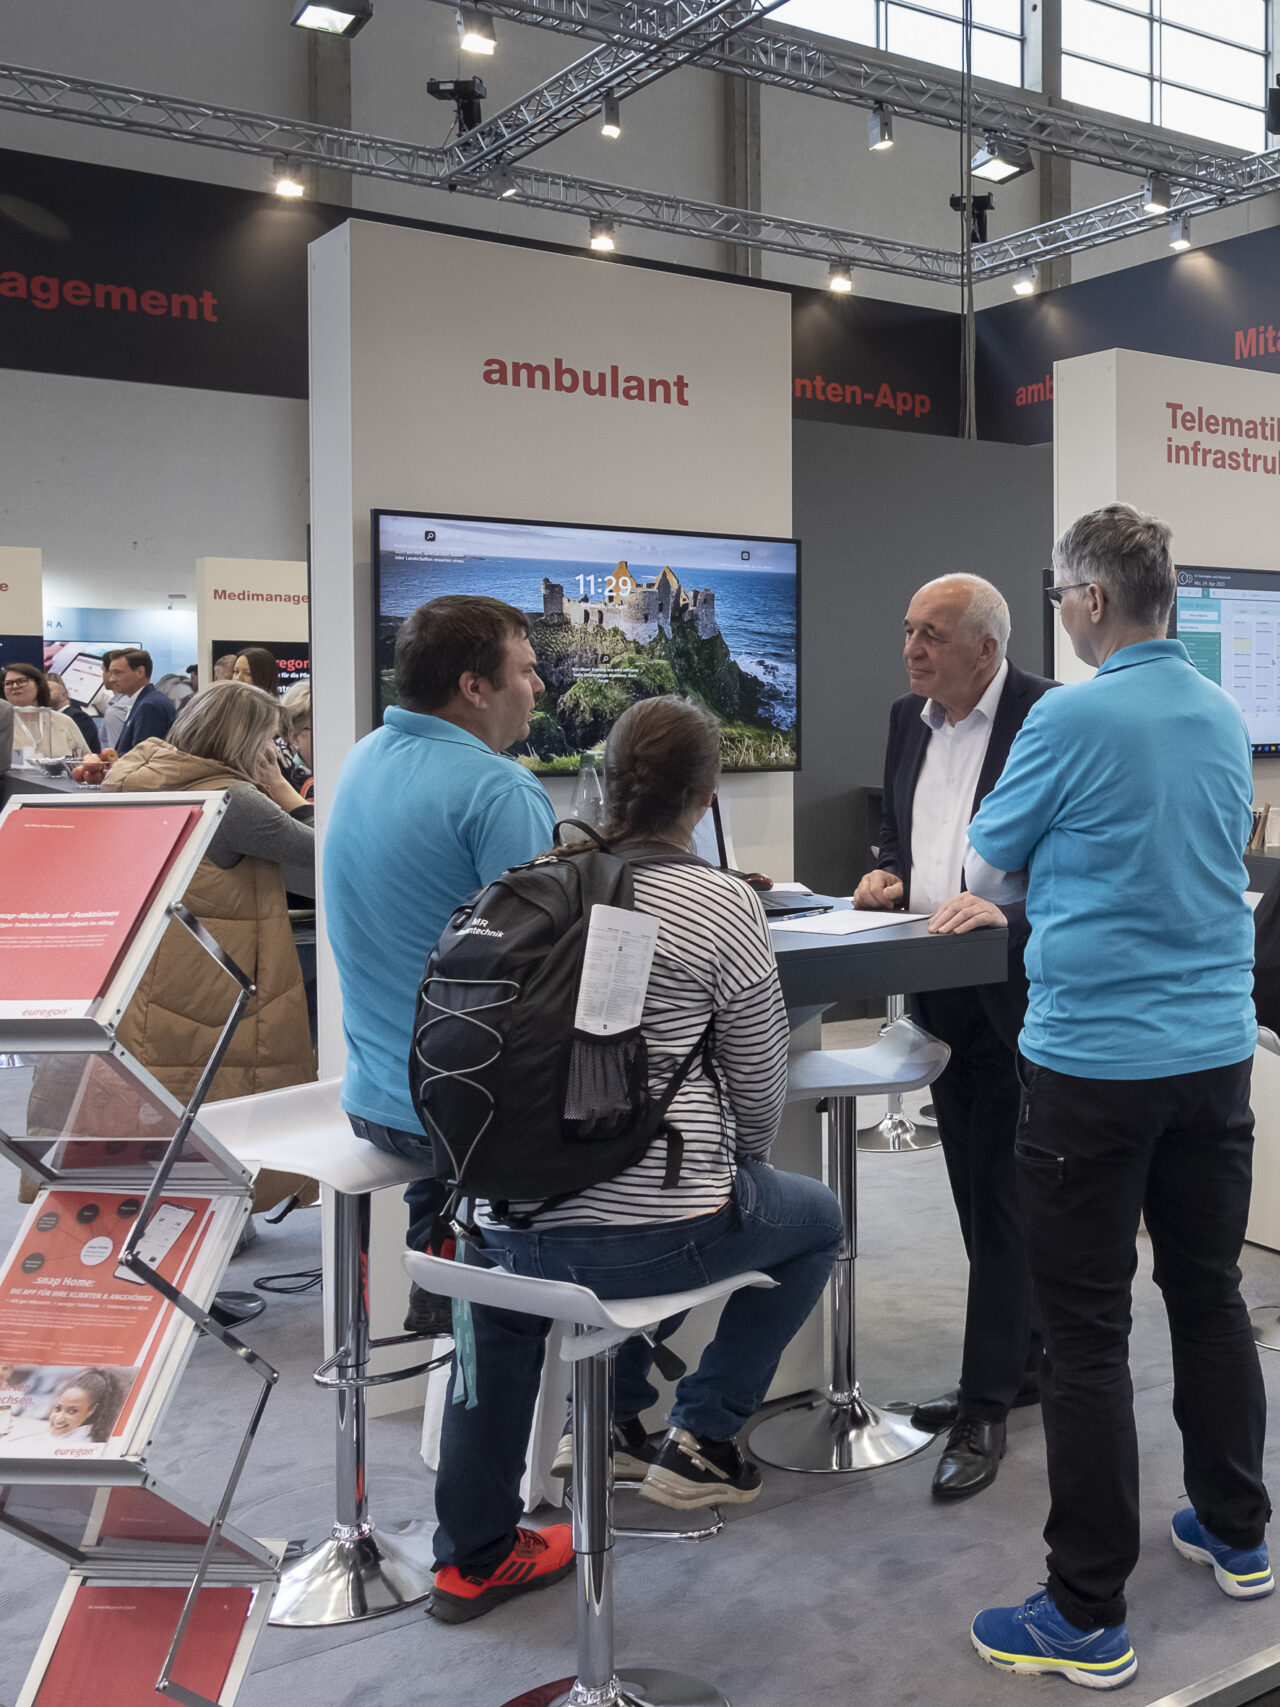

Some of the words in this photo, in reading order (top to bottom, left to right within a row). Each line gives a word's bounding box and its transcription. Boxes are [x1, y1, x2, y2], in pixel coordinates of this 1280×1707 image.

[0, 269, 219, 323] agement
[481, 356, 690, 407] ambulant
[792, 375, 931, 418] nten-App
[575, 573, 632, 597] 11:29
[472, 917, 489, 927] MR
[22, 1006, 68, 1018] euregon
[54, 1447, 94, 1457] euregon
